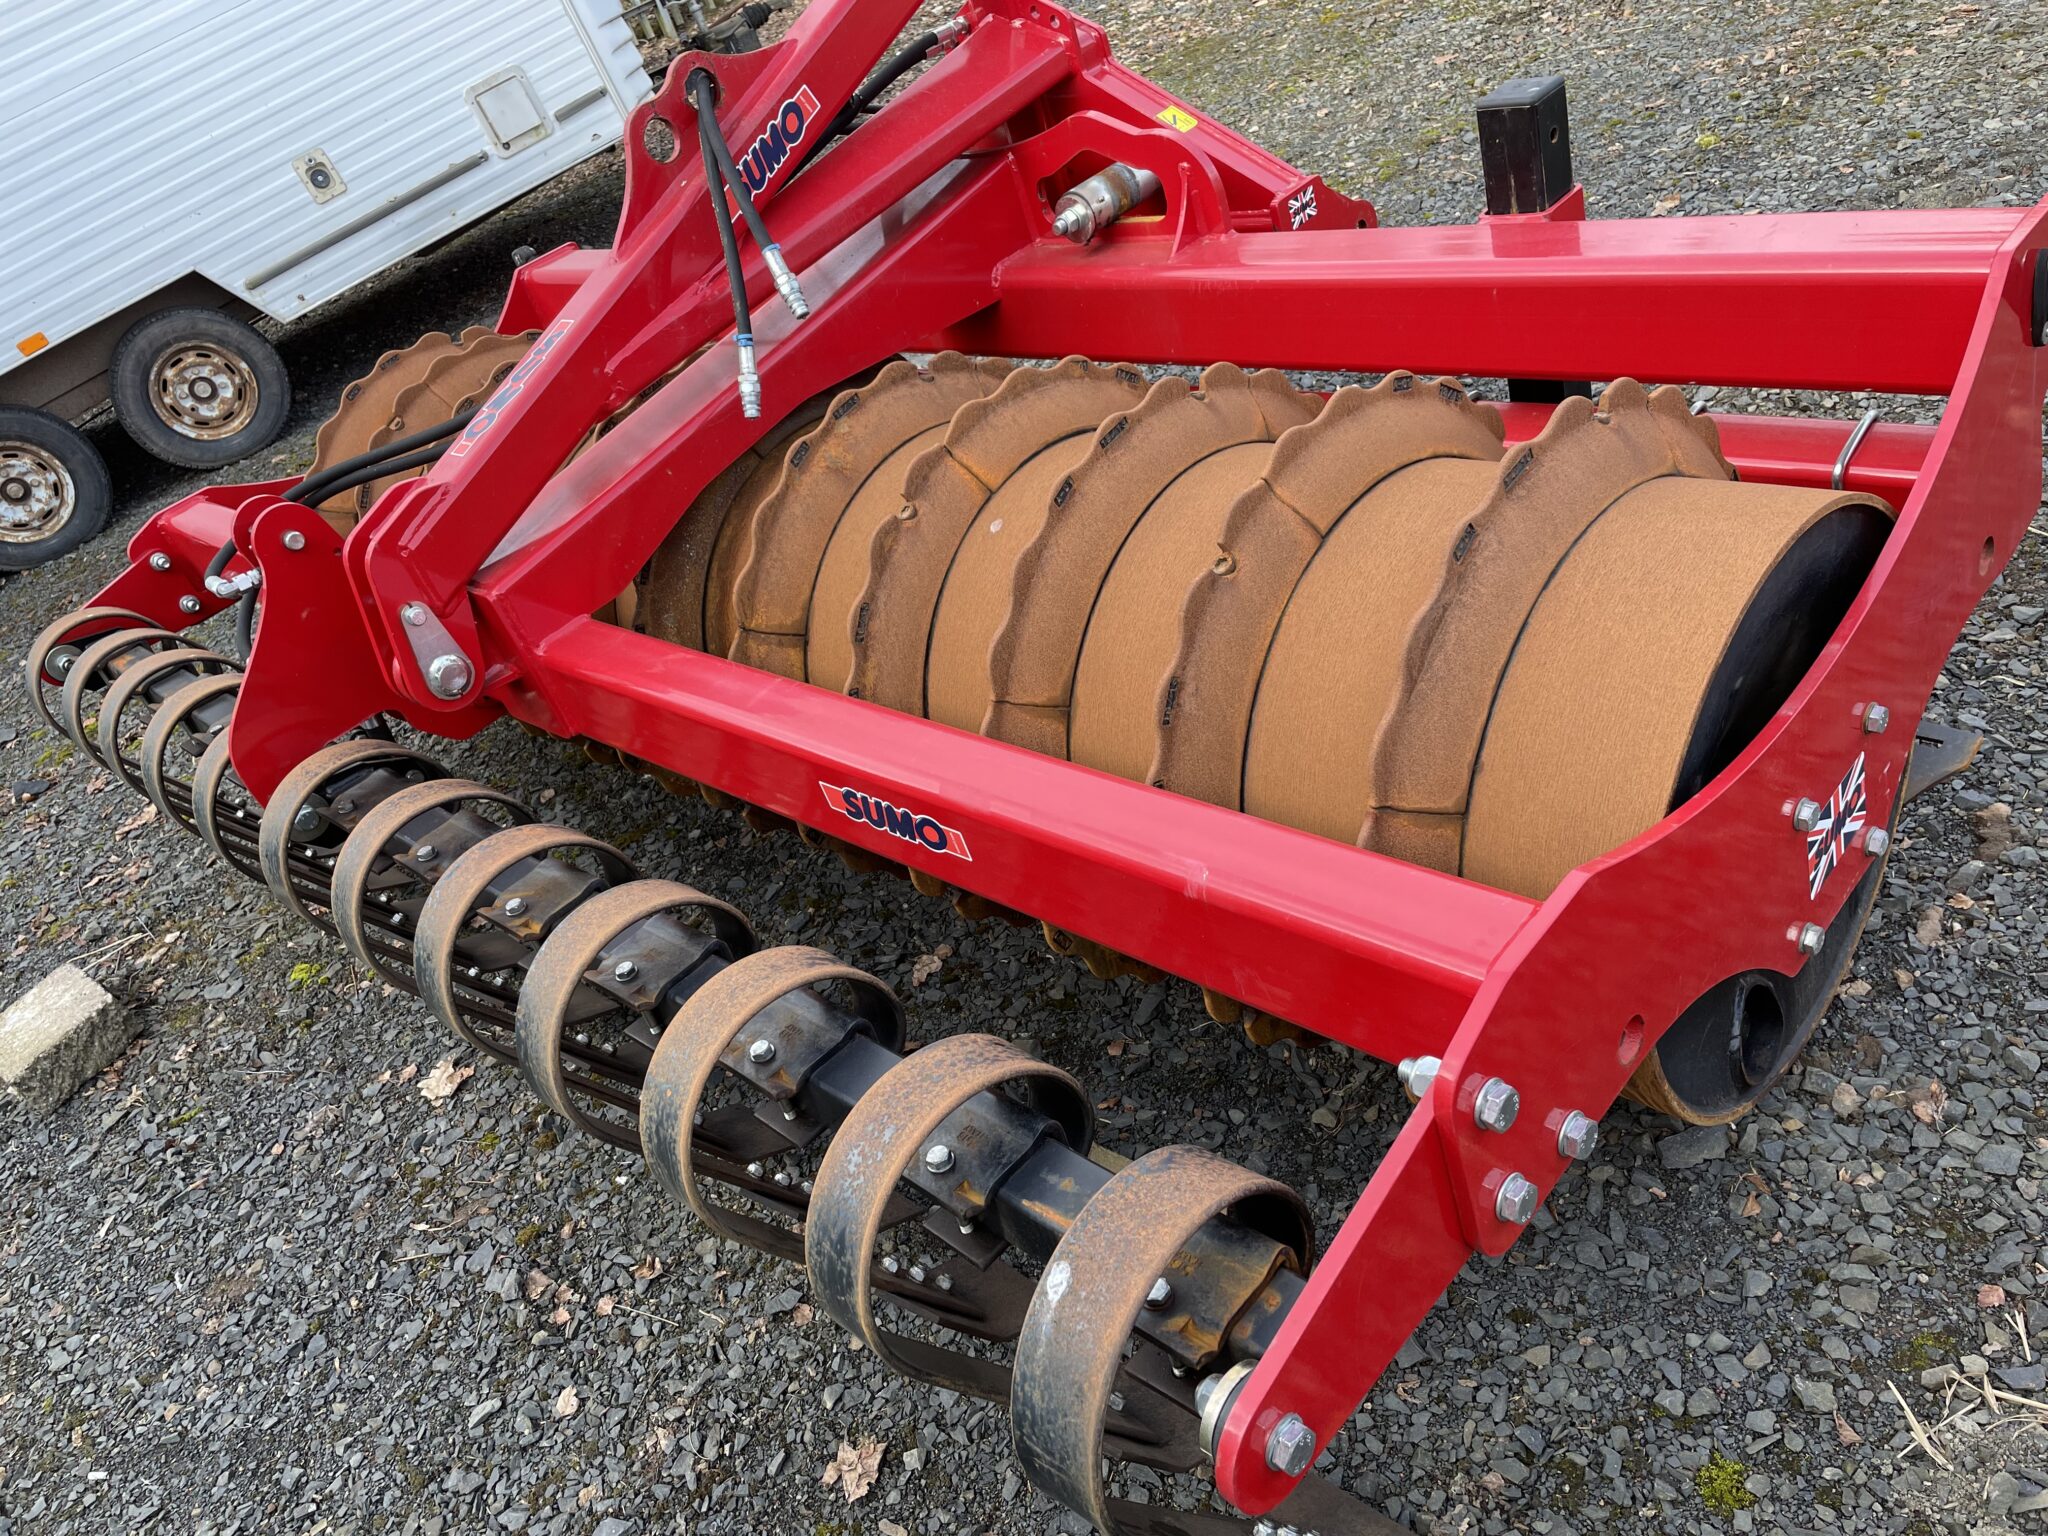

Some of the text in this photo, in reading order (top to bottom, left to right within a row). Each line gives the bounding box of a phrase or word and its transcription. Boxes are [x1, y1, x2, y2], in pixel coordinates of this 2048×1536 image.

[464, 330, 565, 439] SUMO
[842, 789, 948, 851] SUMO
[1814, 781, 1861, 869] SUMO
